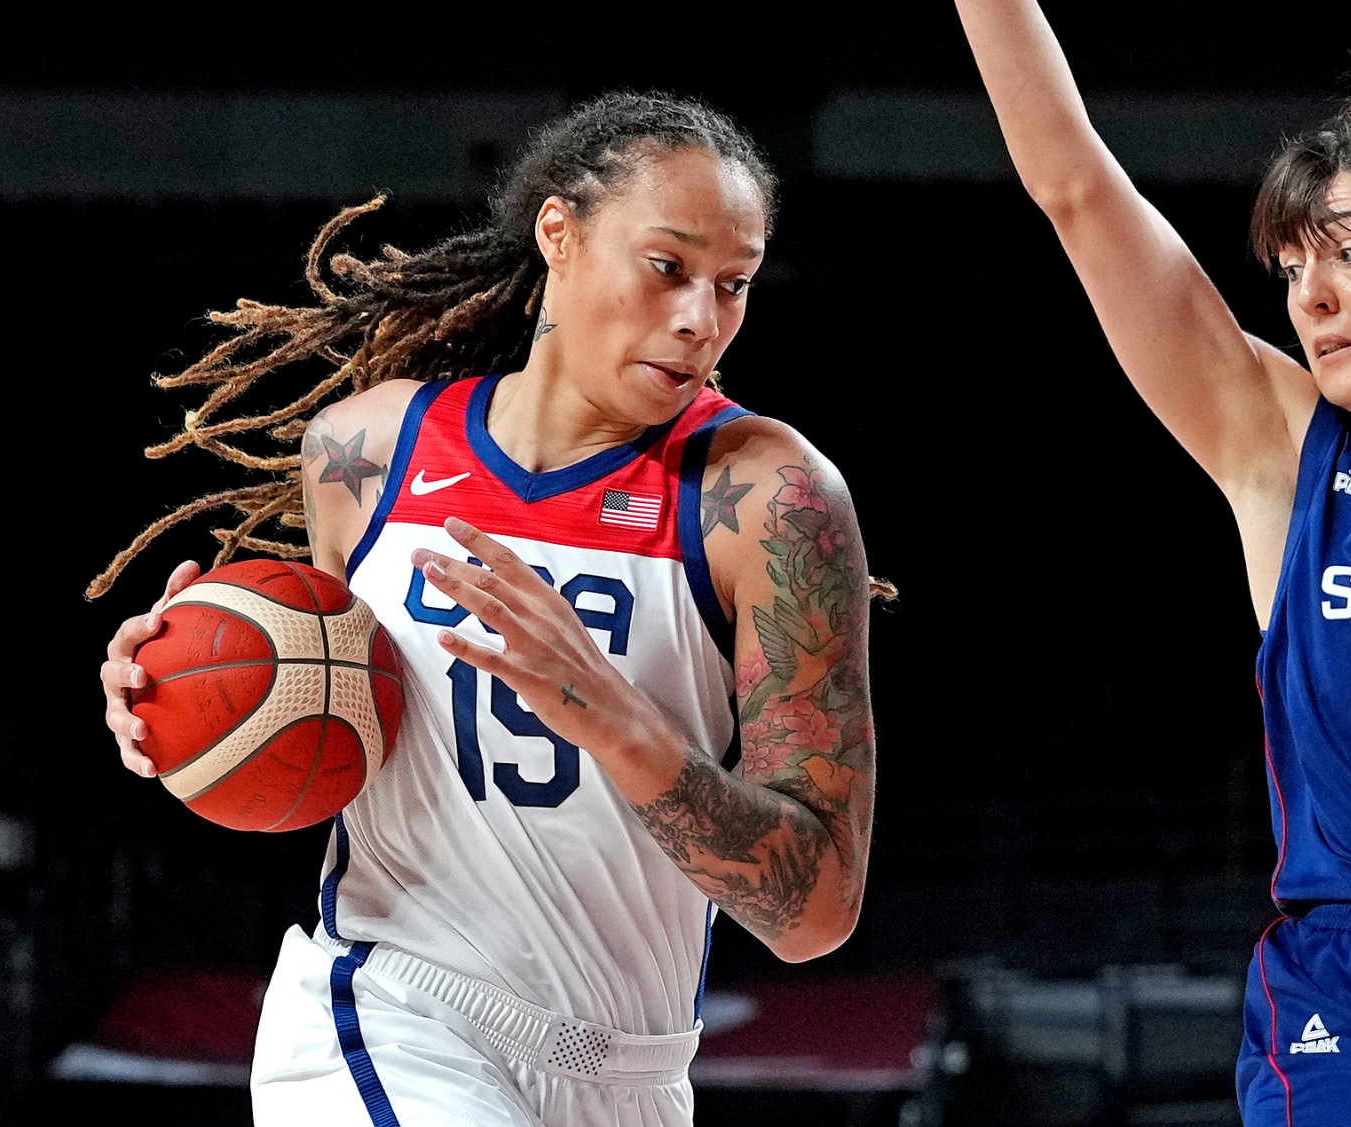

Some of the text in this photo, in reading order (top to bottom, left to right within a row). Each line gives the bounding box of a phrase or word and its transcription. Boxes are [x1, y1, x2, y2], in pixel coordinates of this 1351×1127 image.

[404, 556, 635, 656] UA
[446, 656, 581, 808] 15
[1289, 1035, 1341, 1055] PEAK
